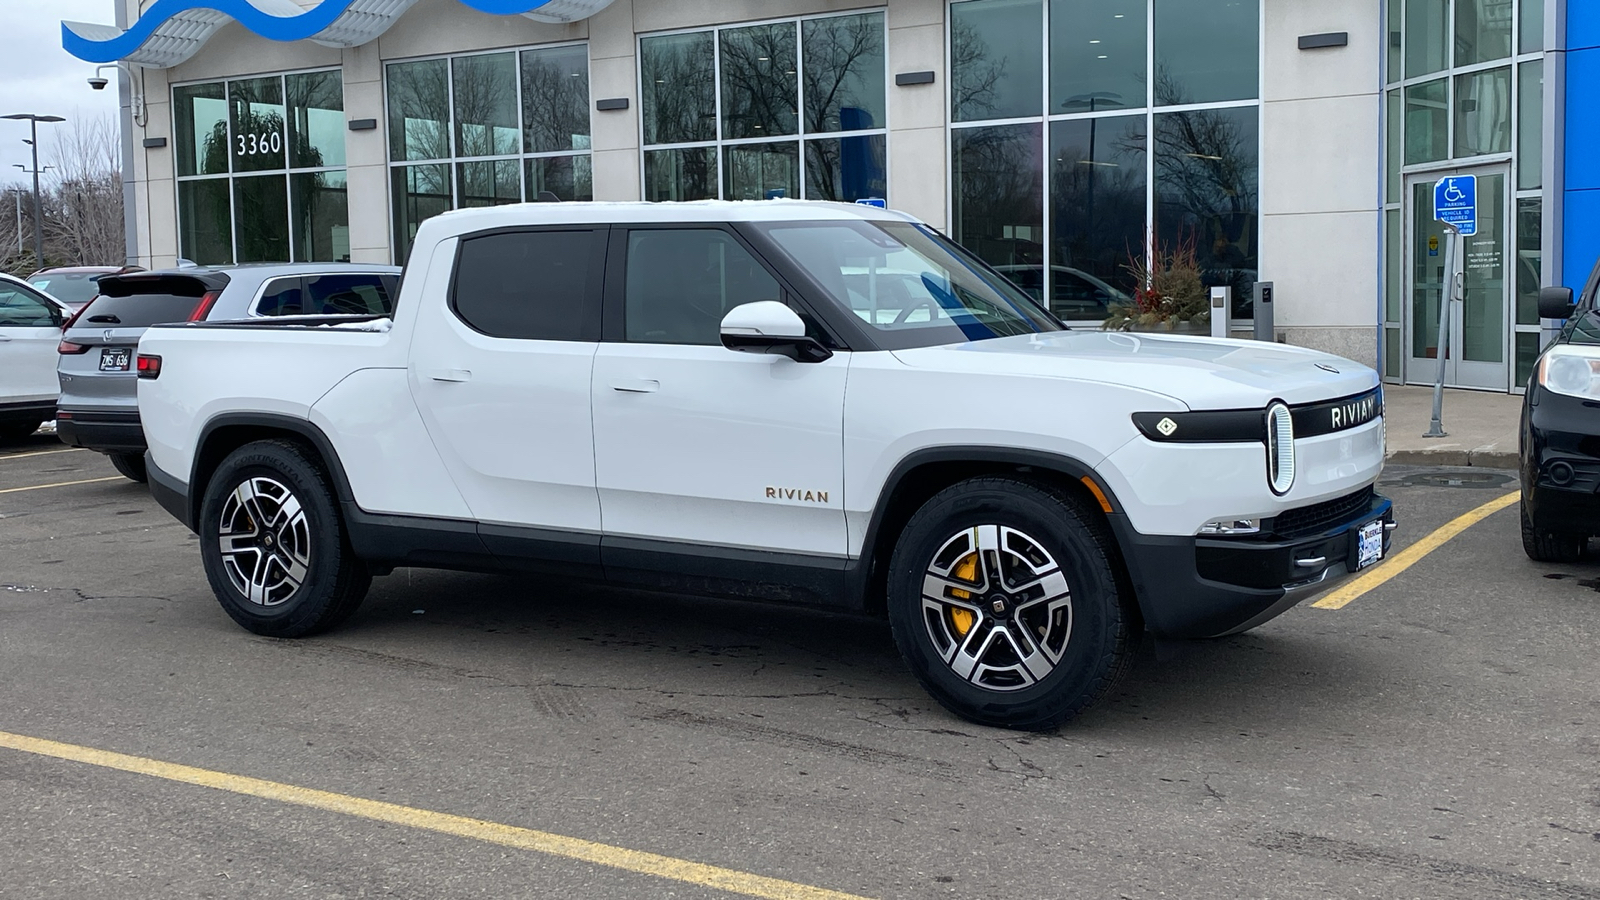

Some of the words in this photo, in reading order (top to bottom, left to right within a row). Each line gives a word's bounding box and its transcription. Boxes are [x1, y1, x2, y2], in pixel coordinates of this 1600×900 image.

[237, 132, 280, 155] 3360
[116, 354, 128, 366] 636
[1331, 398, 1374, 429] RIVIAN
[234, 455, 303, 484] CONTINENTAL
[765, 487, 828, 503] RIVIAN
[1364, 527, 1382, 540] BUERKLE
